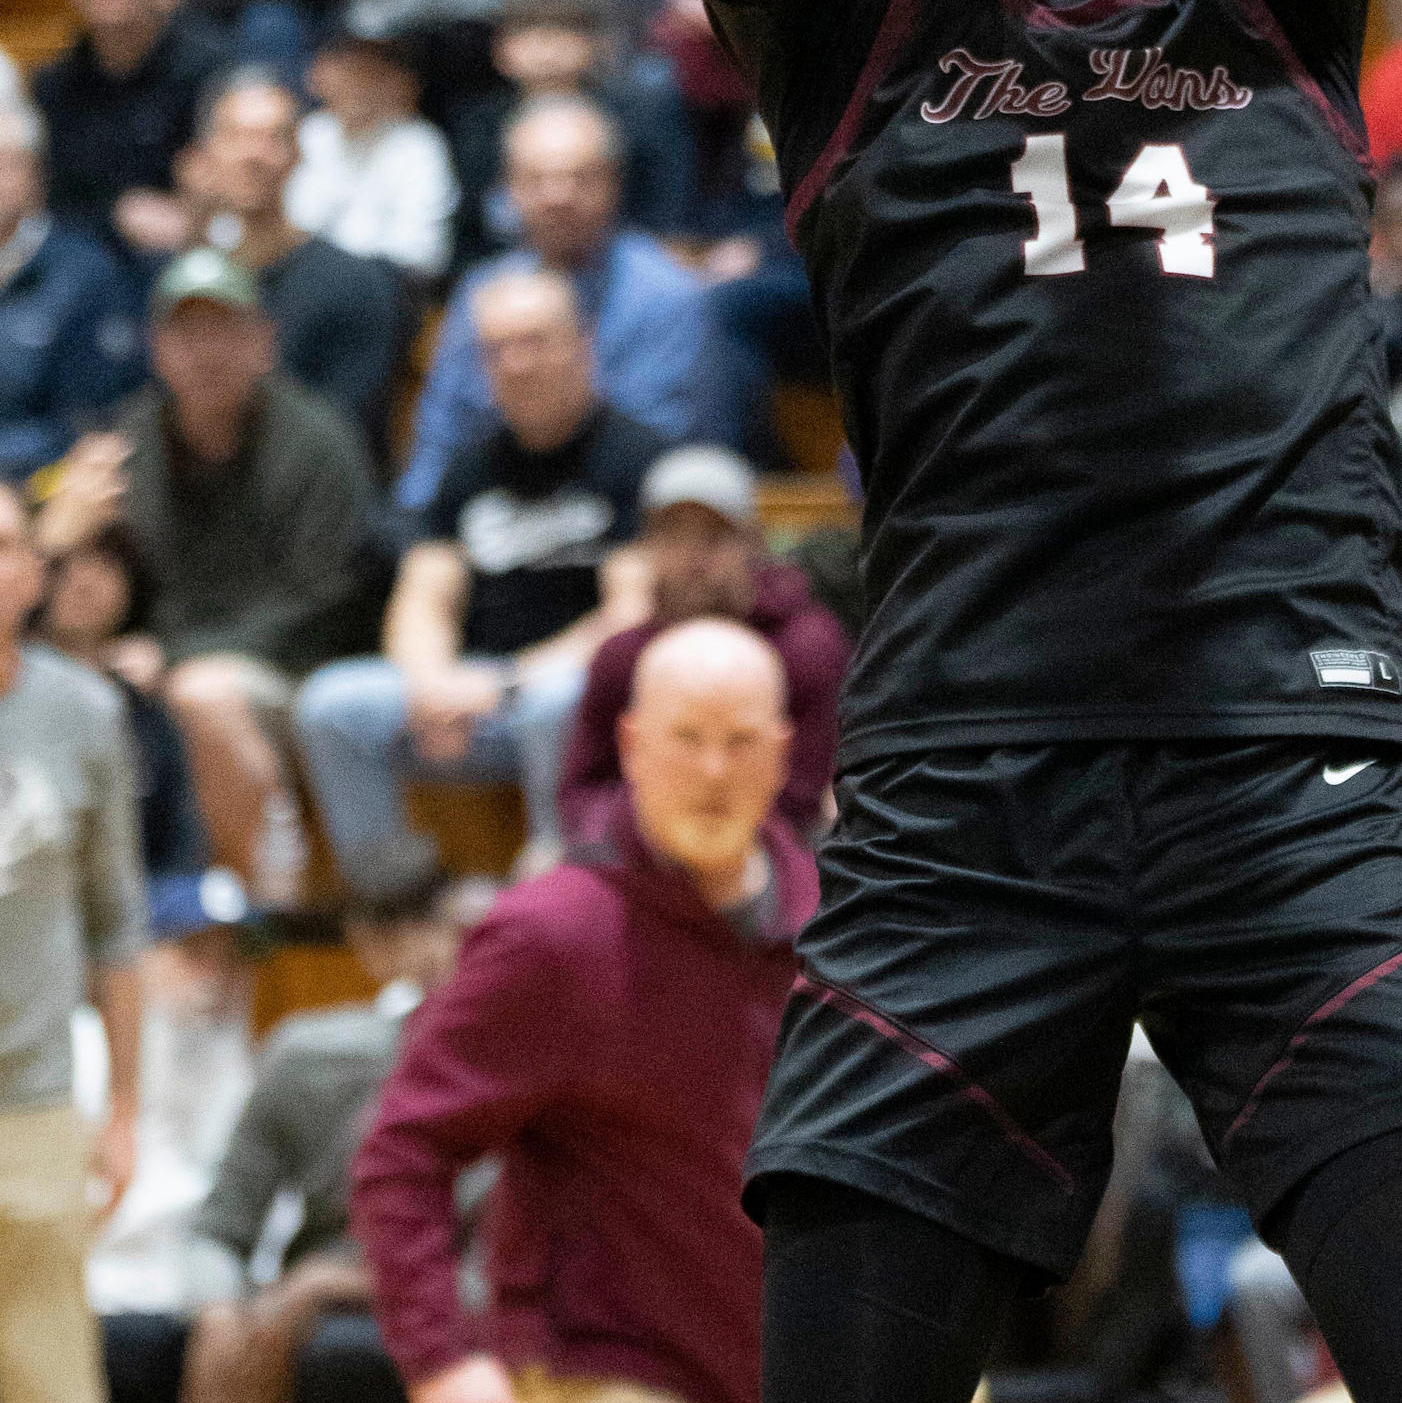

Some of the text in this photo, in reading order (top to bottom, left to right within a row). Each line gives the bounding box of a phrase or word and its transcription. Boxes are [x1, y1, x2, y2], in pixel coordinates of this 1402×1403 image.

[921, 46, 1253, 124] The Dons
[1009, 131, 1219, 280] 14
[1379, 661, 1393, 681] L
